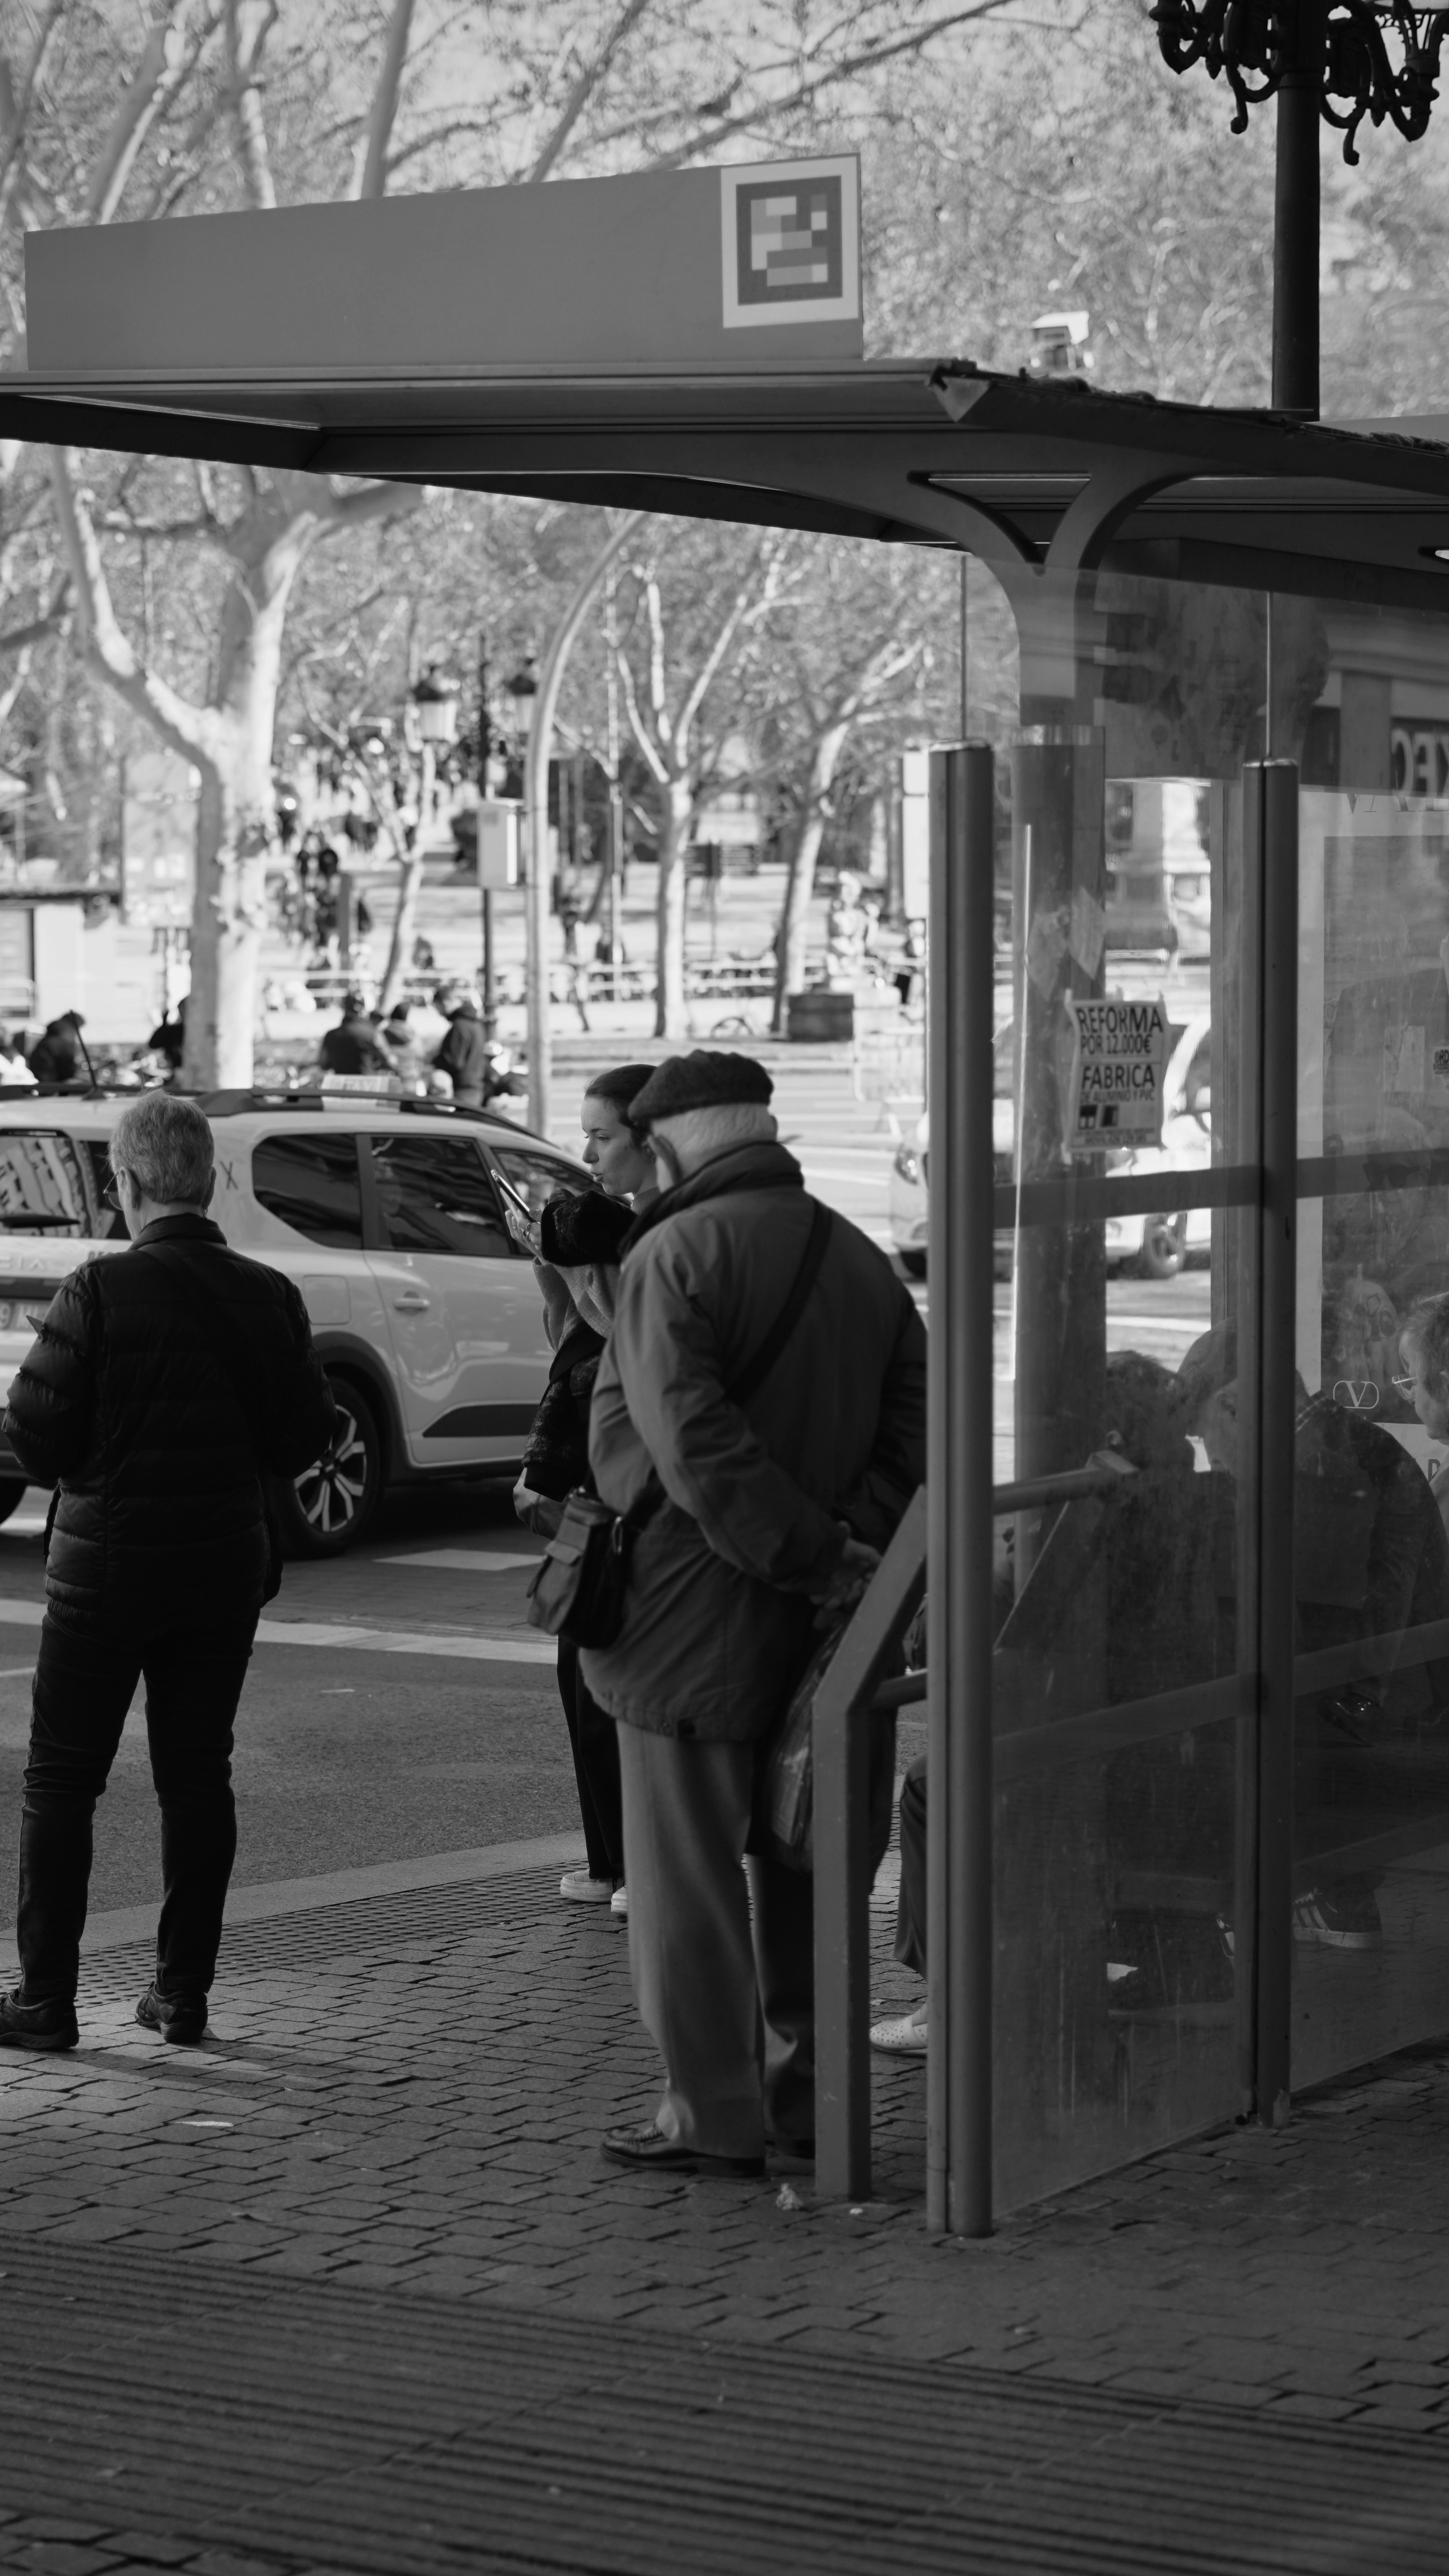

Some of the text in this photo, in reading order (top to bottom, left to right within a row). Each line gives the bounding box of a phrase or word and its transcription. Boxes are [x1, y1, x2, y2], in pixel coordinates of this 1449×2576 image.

[1076, 1006, 1164, 1033] REFORMA
[1080, 1034, 1103, 1055] POR
[1081, 1064, 1155, 1090] FABRICA
